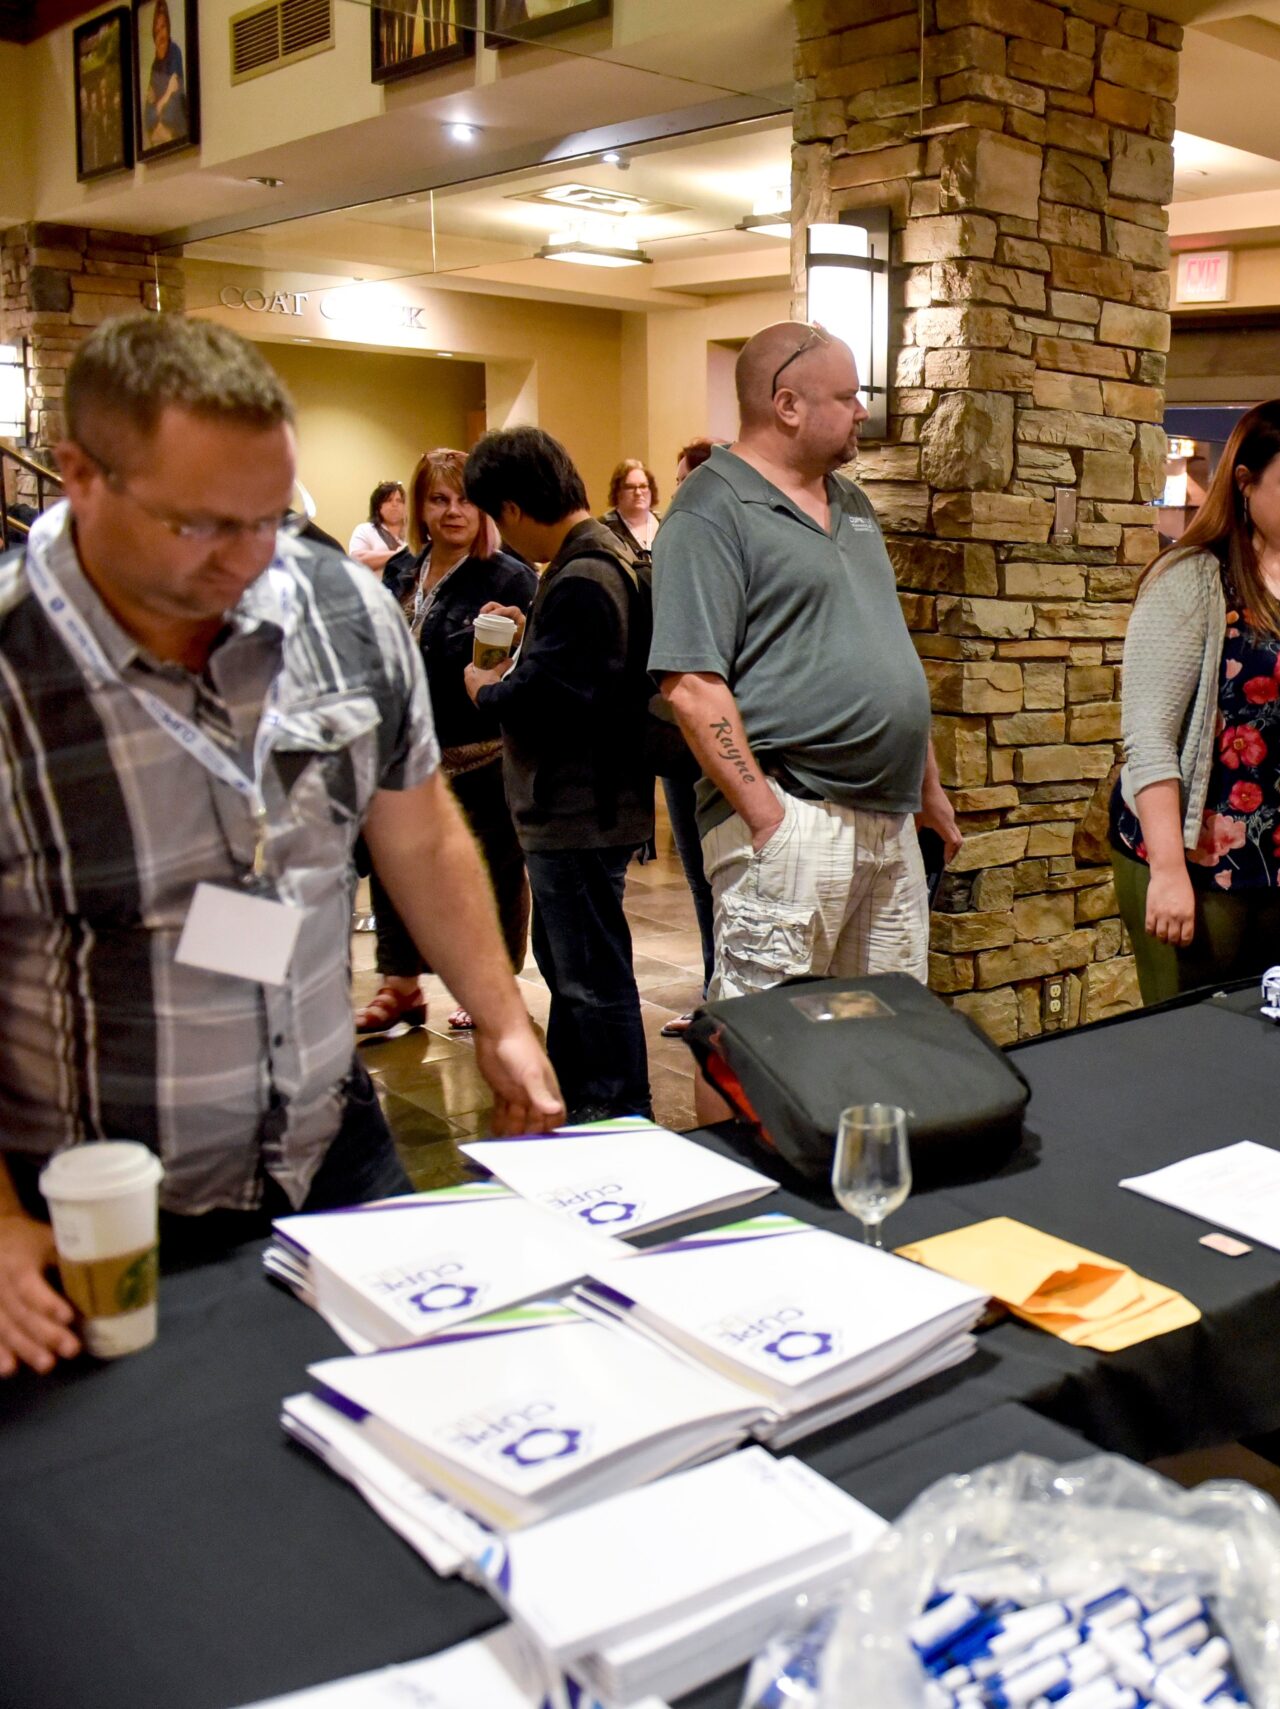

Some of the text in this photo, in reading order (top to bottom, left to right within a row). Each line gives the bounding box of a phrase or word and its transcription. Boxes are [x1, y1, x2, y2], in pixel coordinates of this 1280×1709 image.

[1186, 256, 1221, 292] EXIT
[219, 285, 309, 316] COAT
[550, 1183, 623, 1209] CUPE
[719, 1307, 805, 1344] CUPE
